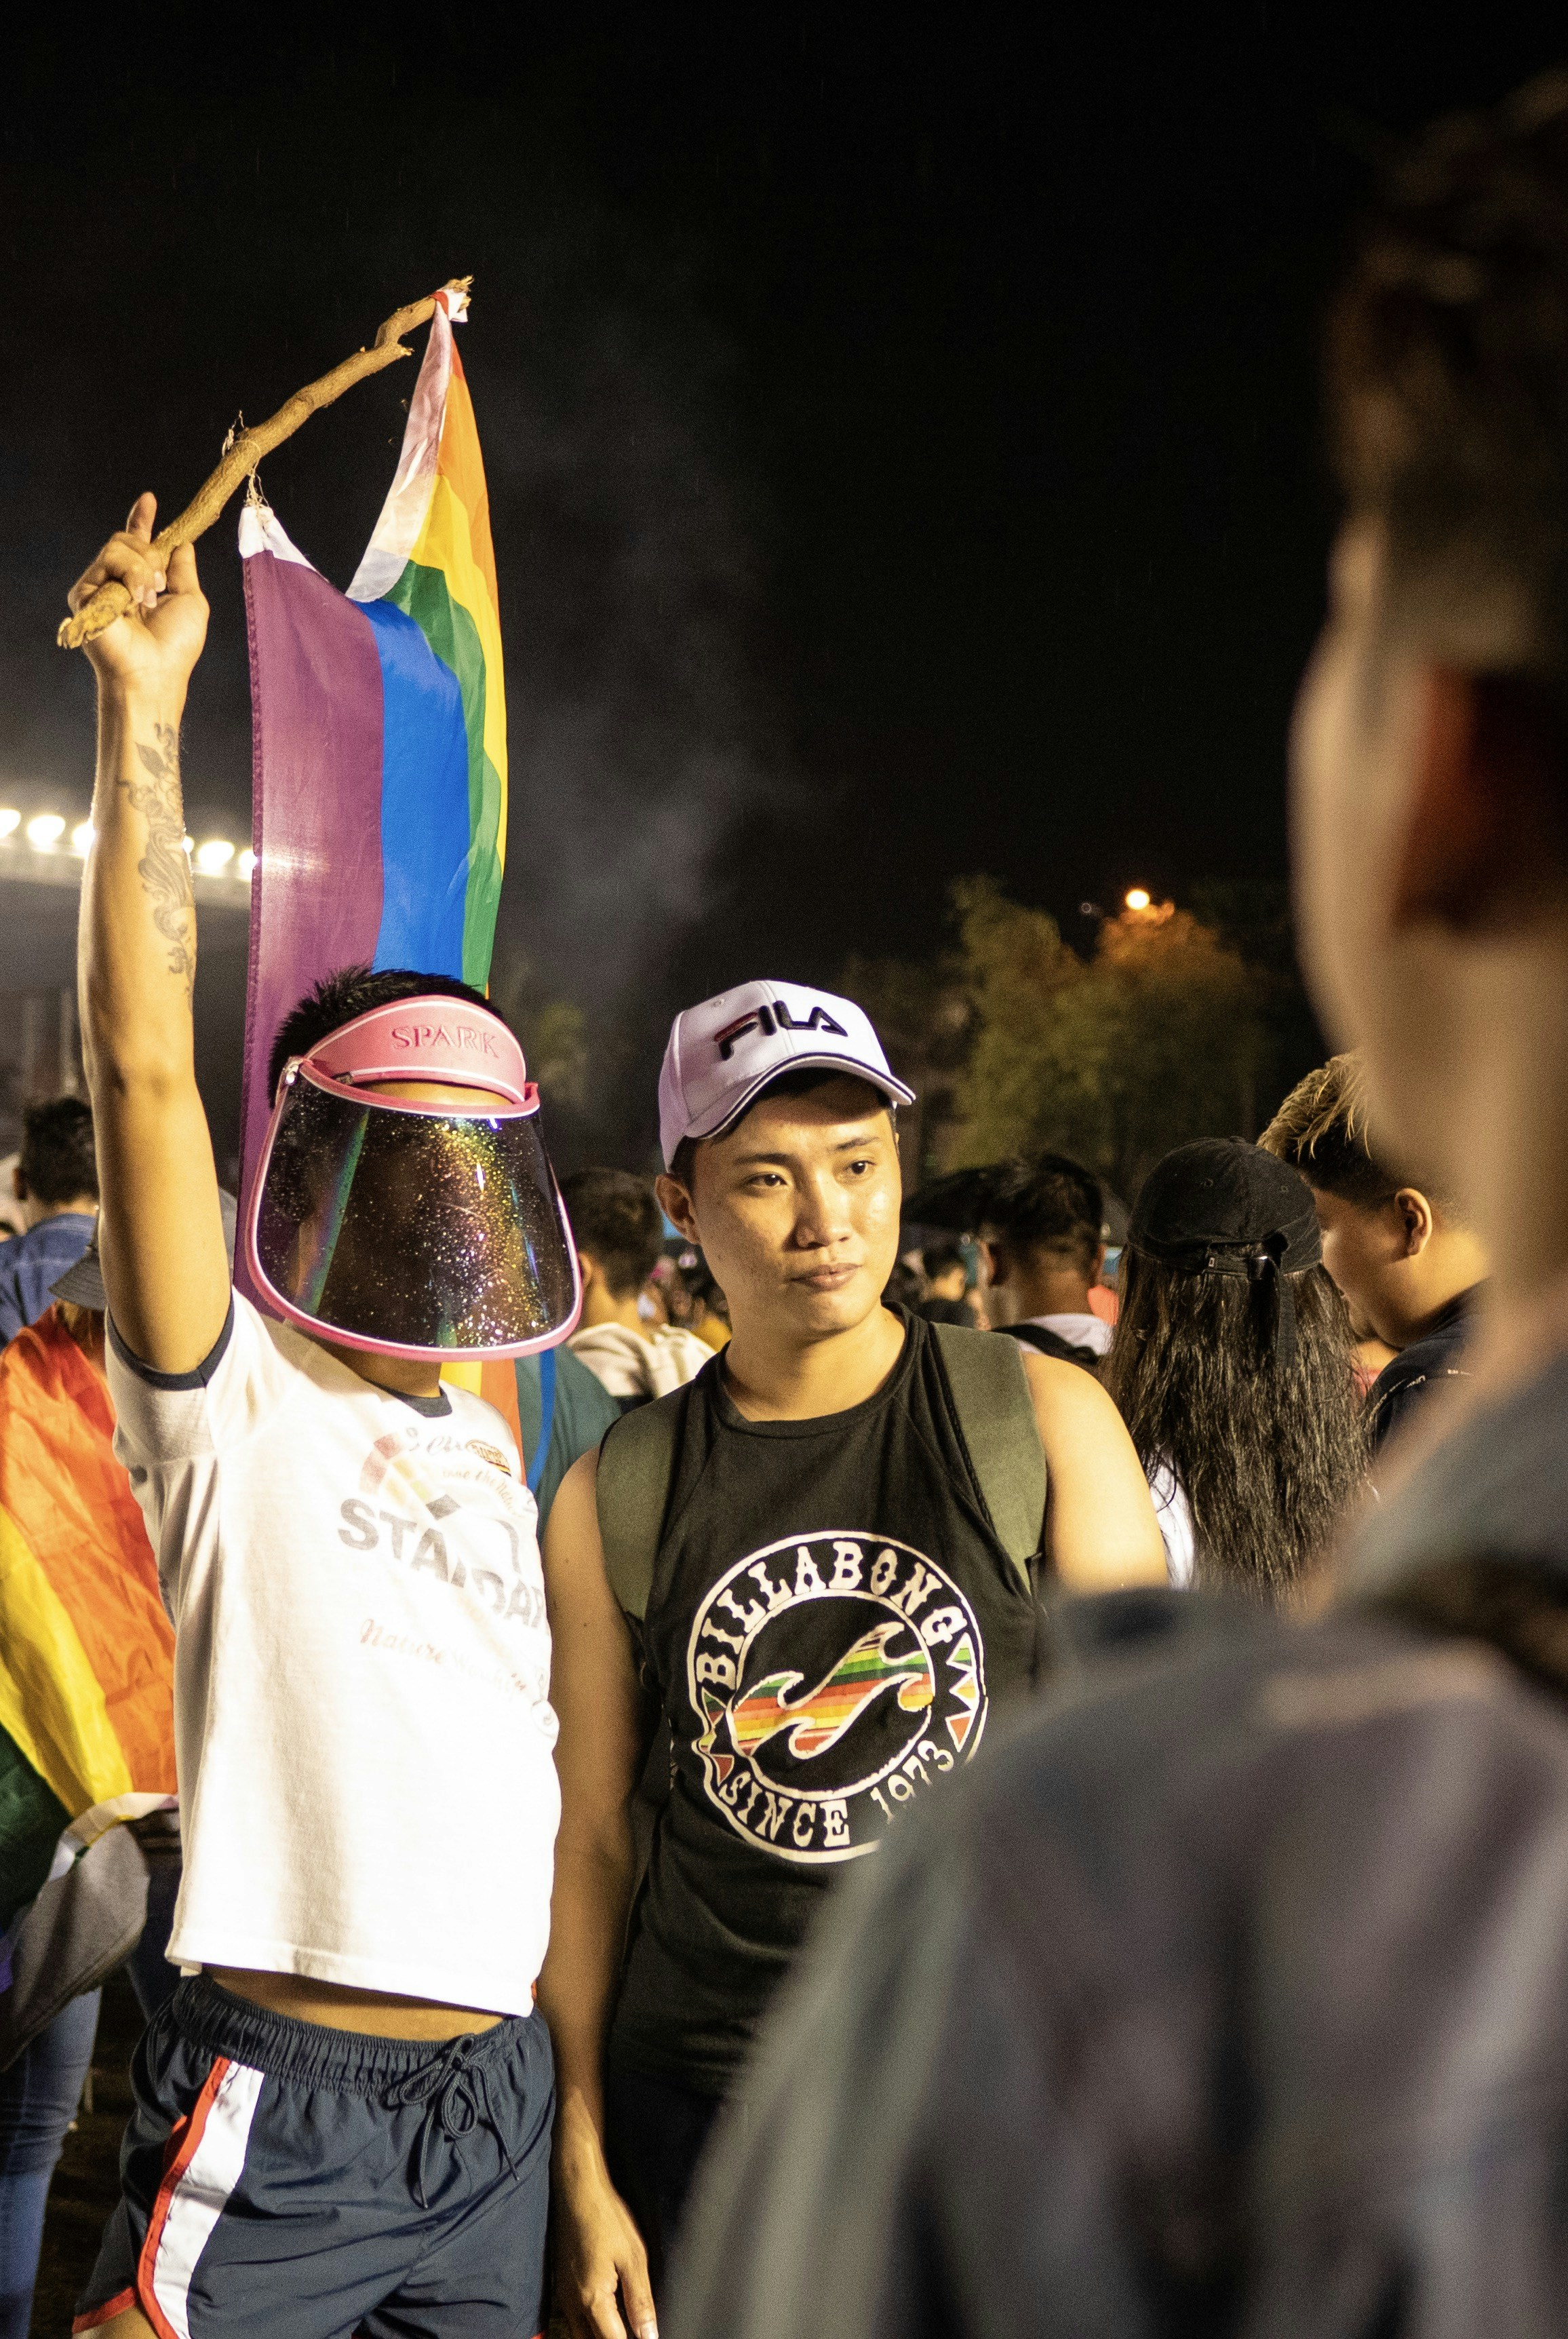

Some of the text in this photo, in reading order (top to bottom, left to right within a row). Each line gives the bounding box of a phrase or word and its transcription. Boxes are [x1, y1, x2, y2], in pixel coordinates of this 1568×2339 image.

[391, 1025, 499, 1058] SPARK
[713, 1000, 848, 1061] FILA
[696, 1541, 968, 1690] BILLABONG
[719, 1771, 850, 1848] SINCE
